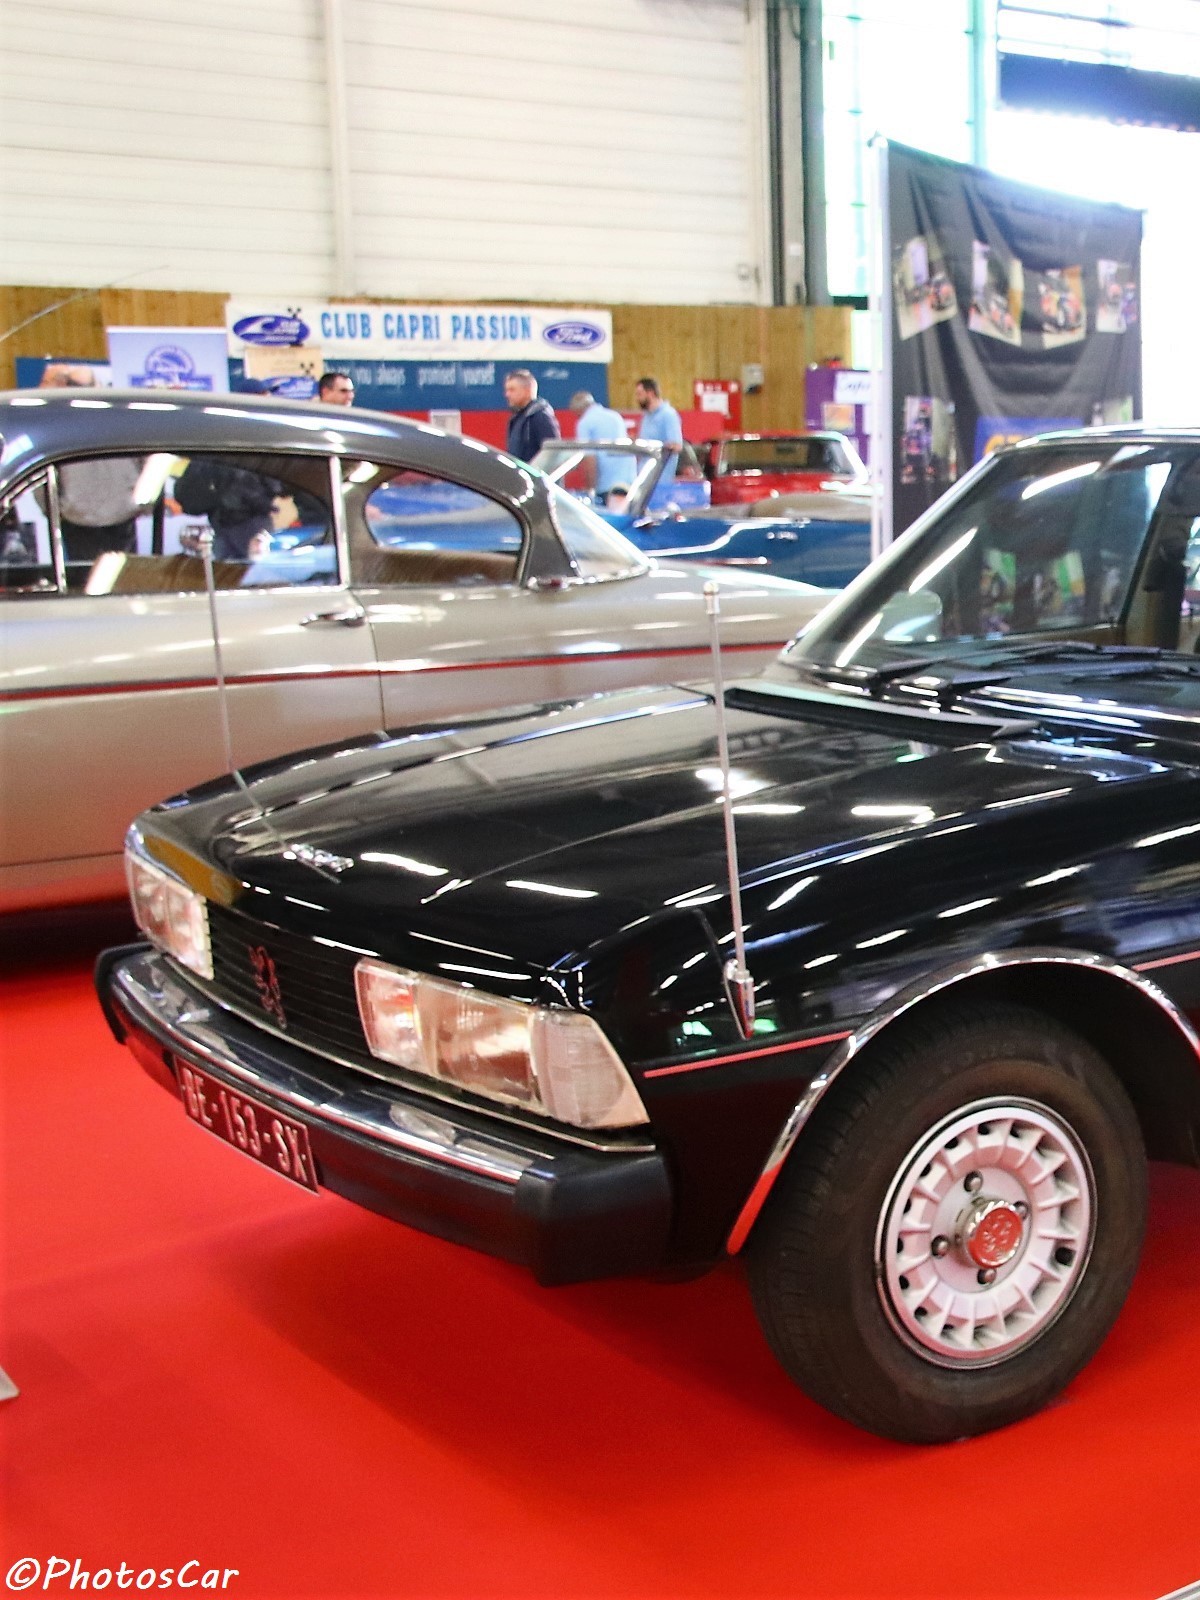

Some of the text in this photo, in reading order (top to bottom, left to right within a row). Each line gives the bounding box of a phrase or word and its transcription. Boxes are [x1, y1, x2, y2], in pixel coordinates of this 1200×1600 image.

[321, 313, 371, 339] CLUB
[384, 313, 440, 341] CAPRI
[452, 315, 532, 341] PASSION
